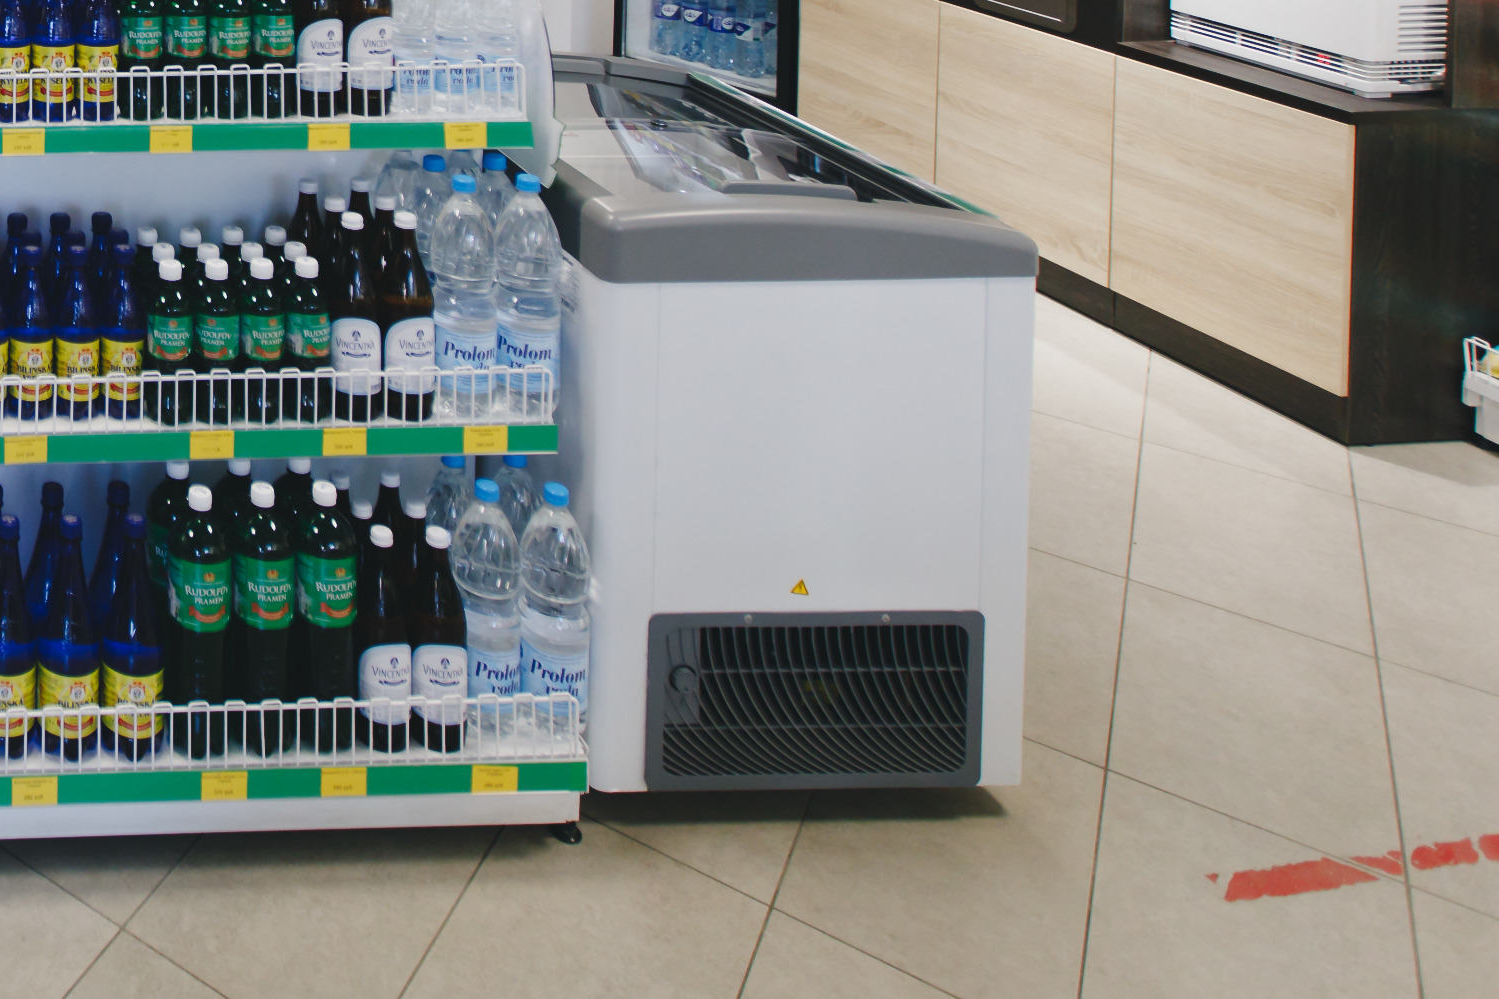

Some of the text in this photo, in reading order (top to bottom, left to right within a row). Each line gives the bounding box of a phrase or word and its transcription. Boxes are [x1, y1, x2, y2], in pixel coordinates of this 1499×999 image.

[160, 339, 186, 347] PRAMEN
[194, 596, 223, 605] PRAMEN
[257, 593, 287, 602] PRAMEN
[325, 592, 353, 601] PRAMEN
[530, 658, 586, 684] Prolom
